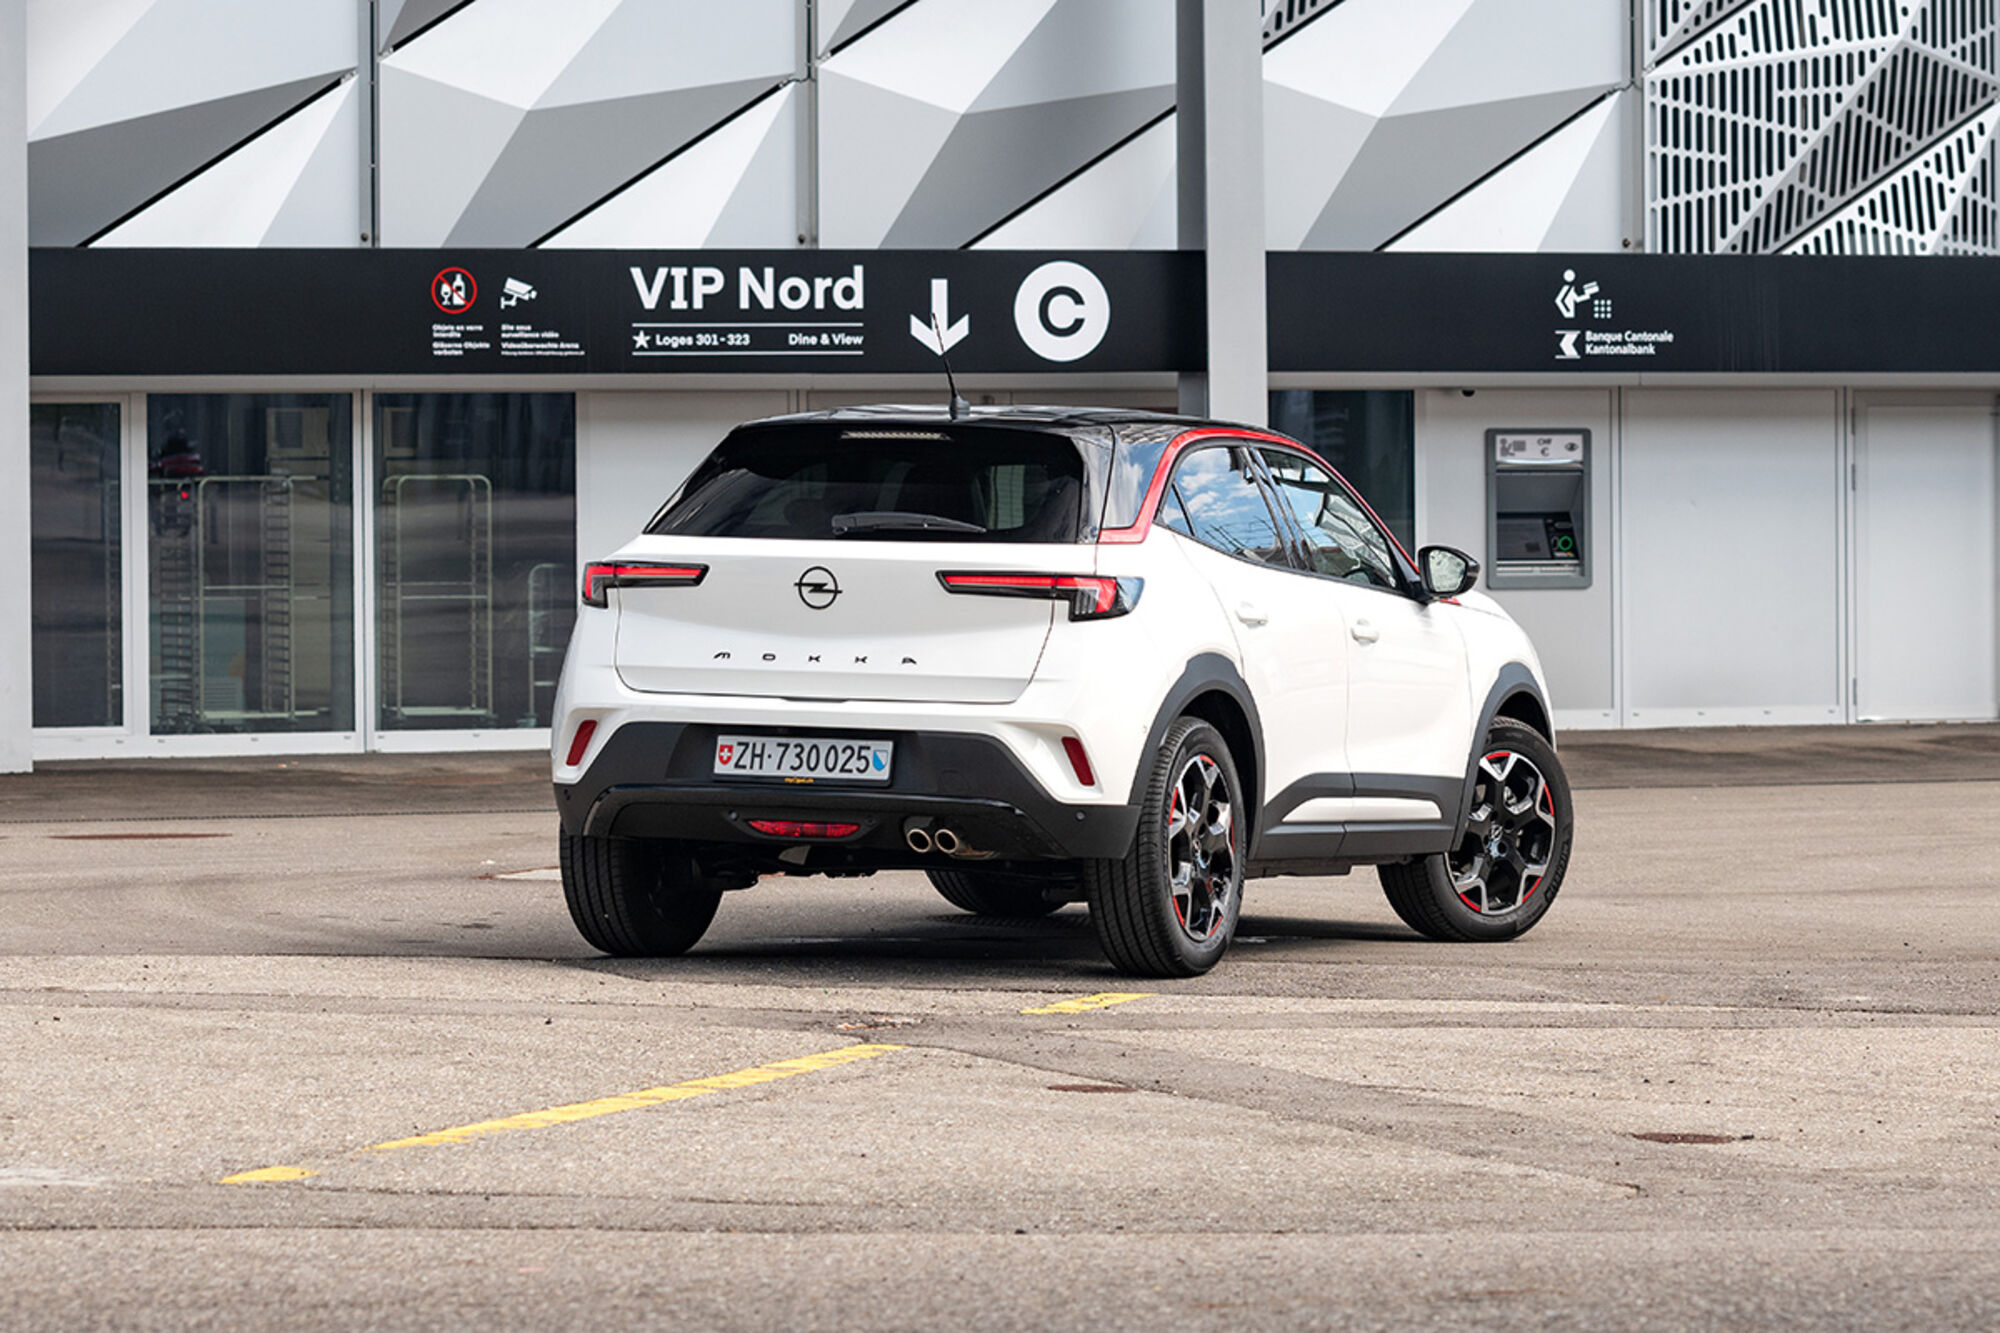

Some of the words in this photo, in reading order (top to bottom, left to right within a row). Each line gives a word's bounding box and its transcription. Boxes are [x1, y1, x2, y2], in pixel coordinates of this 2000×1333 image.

[630, 266, 725, 310] VIP
[739, 265, 865, 310] Nord
[1038, 286, 1086, 338] C
[655, 333, 694, 348] Loges
[695, 333, 751, 346] 301-323
[788, 333, 818, 346] Dine
[819, 333, 831, 346] &
[832, 333, 865, 346] View
[1585, 330, 1623, 343] Banque
[1624, 330, 1674, 342] Cantonale
[1585, 343, 1656, 355] Kantonalbank
[714, 651, 917, 665] MOKKA
